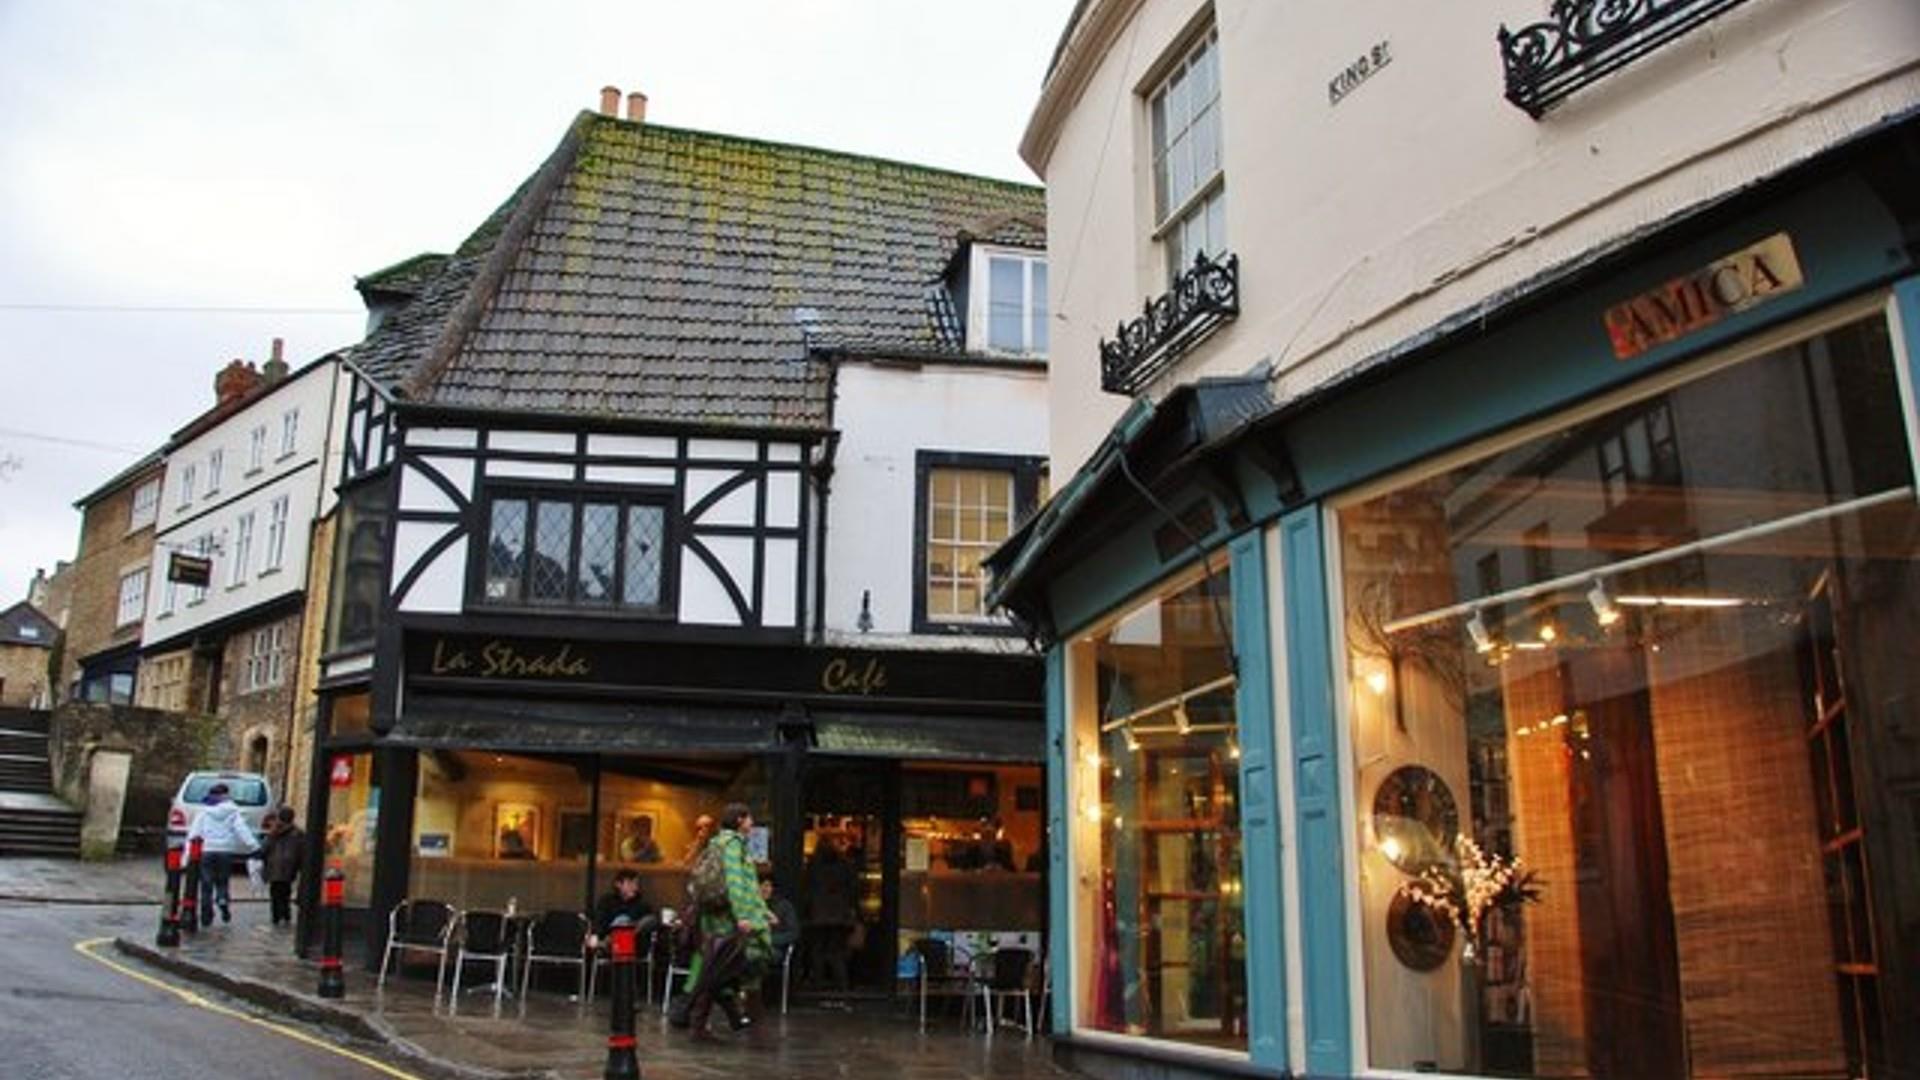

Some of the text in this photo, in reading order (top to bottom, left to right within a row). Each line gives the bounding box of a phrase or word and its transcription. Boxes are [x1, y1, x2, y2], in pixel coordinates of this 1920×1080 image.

[1328, 55, 1369, 103] KING
[1623, 253, 1783, 345] AMICA
[432, 640, 591, 677] La Strada
